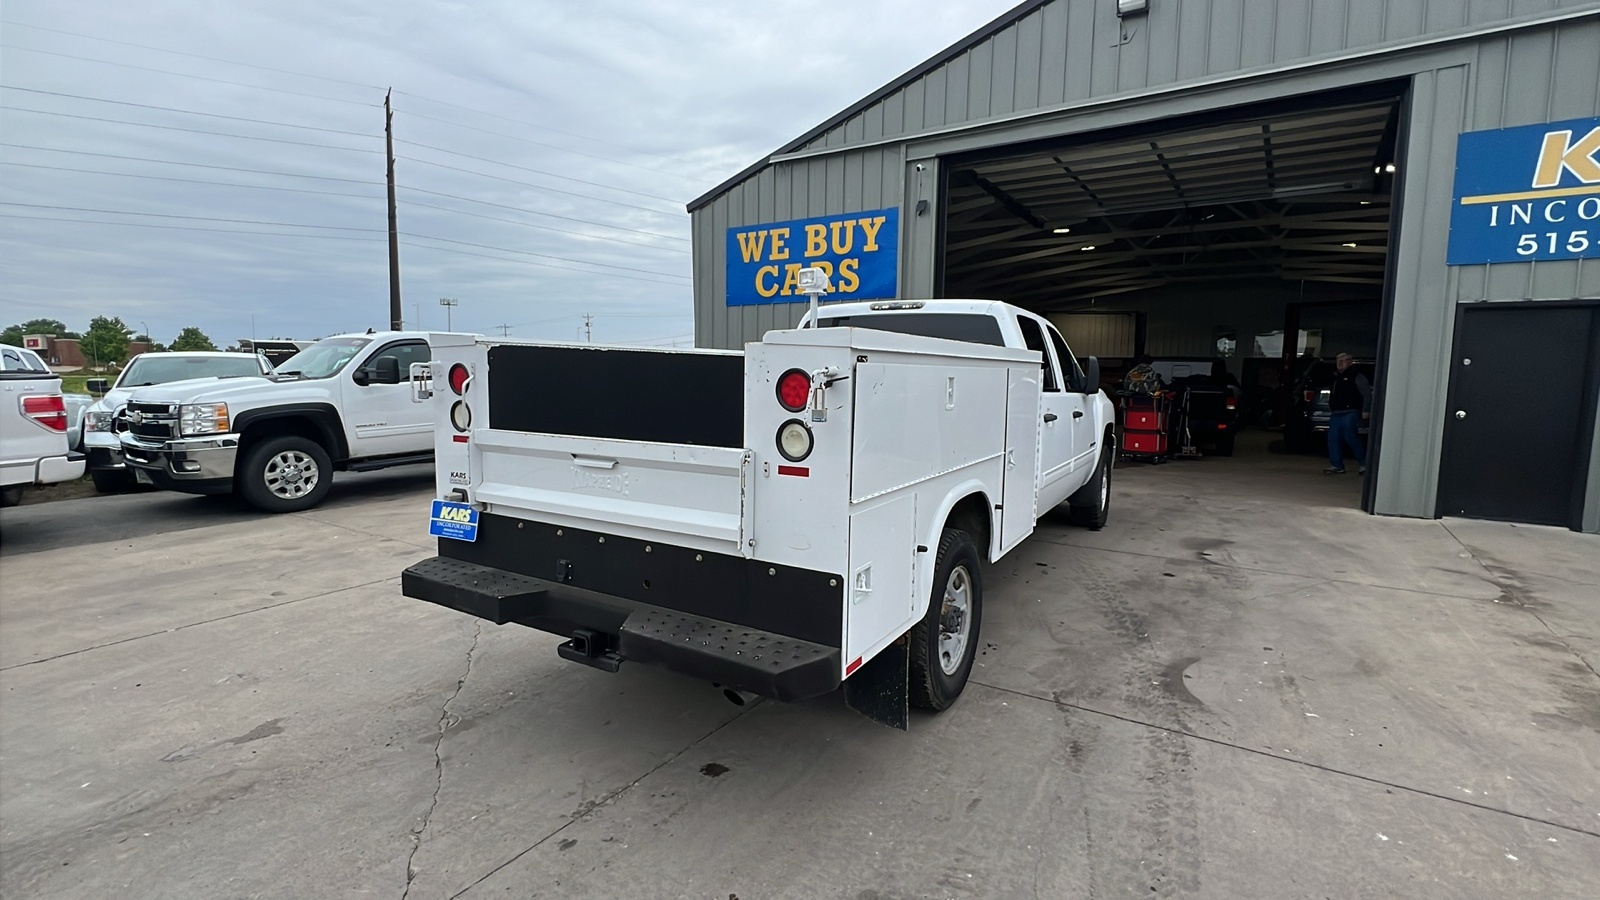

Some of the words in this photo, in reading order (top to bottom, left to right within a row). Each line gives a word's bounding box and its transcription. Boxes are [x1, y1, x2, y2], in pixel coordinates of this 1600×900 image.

[737, 227, 790, 263] WE
[804, 216, 886, 258] BUY
[1516, 230, 1600, 255] 515
[450, 471, 467, 479] KARS
[440, 506, 472, 523] KARS
